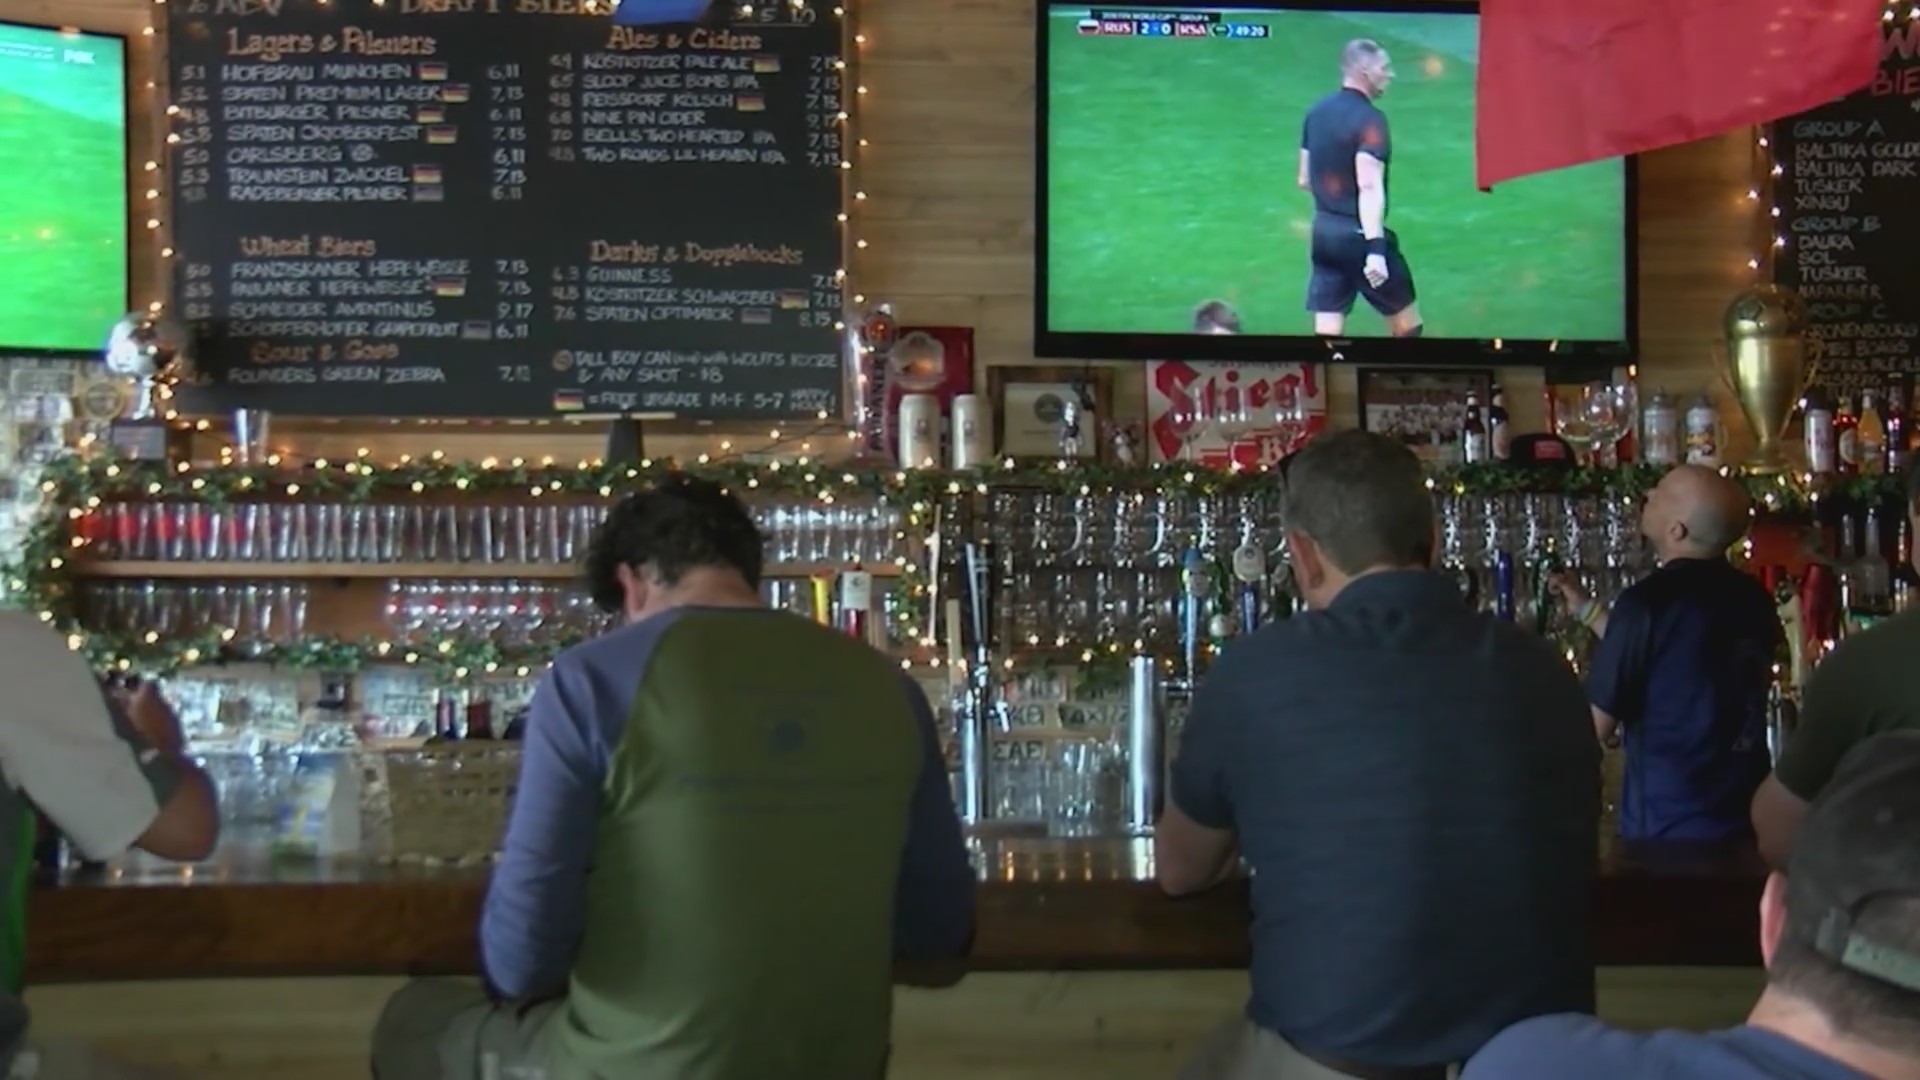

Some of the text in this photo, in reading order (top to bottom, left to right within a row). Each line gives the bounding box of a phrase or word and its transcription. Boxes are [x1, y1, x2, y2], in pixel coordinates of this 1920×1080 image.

[1103, 20, 1132, 33] RUS
[1140, 22, 1149, 34] 2
[1160, 22, 1171, 35] 0
[227, 27, 315, 61] Lagers
[342, 26, 437, 55] Pilsners
[605, 25, 660, 50] Ales
[689, 29, 762, 50] Ciders
[685, 55, 720, 70] PALE
[721, 56, 755, 71] ALE
[582, 74, 636, 89] SLOOP
[640, 74, 683, 89] JUICE
[221, 85, 286, 101] SPATEN
[296, 85, 381, 101] PREMIUM
[385, 85, 442, 102] LAGER
[582, 92, 667, 108] REISSDORF
[224, 104, 329, 121] BITBURGER
[337, 104, 411, 121] PILSNER
[583, 111, 623, 125] NINE
[628, 111, 656, 125] PIN
[658, 111, 706, 126] CIDER
[227, 124, 295, 142] SPATEN
[301, 124, 423, 141] OKTOBERFEST
[643, 129, 677, 143] TWO
[678, 130, 745, 145] HEARTED
[1792, 119, 1886, 138] GROUP A
[226, 146, 342, 164] CARLSBERG
[582, 147, 618, 162] TWO
[620, 148, 672, 162] ROADS
[700, 149, 759, 163] HEAVEN
[1795, 142, 1868, 161] BALTIKA
[227, 167, 328, 184] TRAUNSTEIN
[333, 167, 411, 183] ZWICKEL
[1795, 160, 1917, 178] BALTIKA DARK
[229, 186, 342, 202] RADEBERGER
[343, 187, 409, 201] PILSNER
[1793, 178, 1863, 194] TUSKER
[1793, 194, 1850, 212] XINGU
[1791, 215, 1881, 233] GROUP B
[239, 234, 377, 257] Wheat Biers
[1798, 250, 1837, 265] SOL
[231, 261, 362, 279] FRANZISKANER
[587, 265, 673, 284] GUINNESS
[1799, 266, 1869, 282] TUSKER
[231, 281, 311, 298] PAULANER
[229, 301, 328, 319] SCHNEIDER
[334, 301, 436, 318] AVENTINUS
[585, 305, 648, 322] SPATEN
[650, 307, 735, 321] OPTIMATOR
[374, 321, 460, 338] GRAPEFRUIT
[251, 341, 313, 364] Sour
[574, 350, 607, 367] TALL
[611, 350, 643, 367] BOY
[228, 366, 446, 384] FOUNDERS GREEN ZEBRA
[600, 367, 633, 383] ANY
[637, 368, 680, 384] SHOT
[1153, 360, 1319, 461] Stiegl
